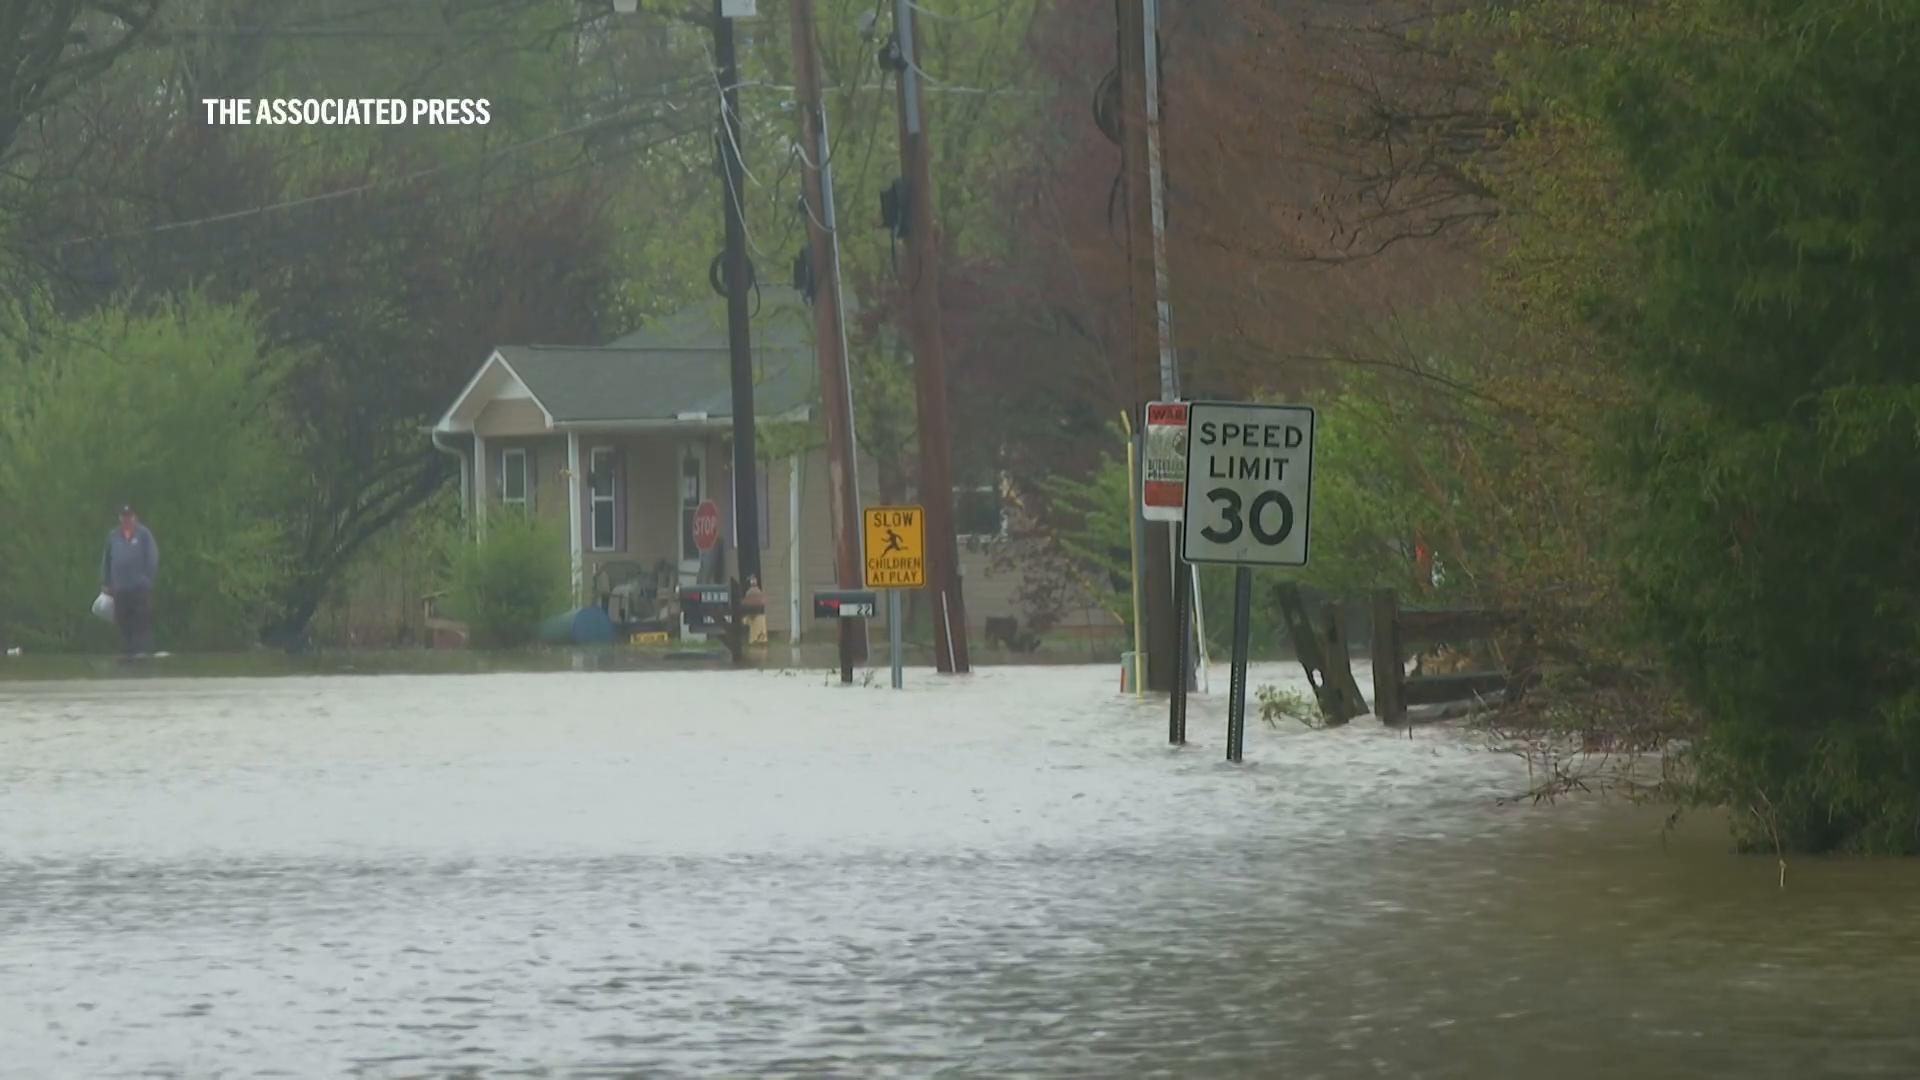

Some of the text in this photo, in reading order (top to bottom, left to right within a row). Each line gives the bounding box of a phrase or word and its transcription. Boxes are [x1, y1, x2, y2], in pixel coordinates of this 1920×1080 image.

[1200, 421, 1303, 449] SPEED
[1209, 455, 1289, 481] LIMIT
[694, 515, 716, 536] STOP
[873, 511, 914, 528] SLOW
[1200, 487, 1294, 547] 30
[867, 557, 921, 570] CHILDREN
[872, 571, 917, 584] AT PLAY
